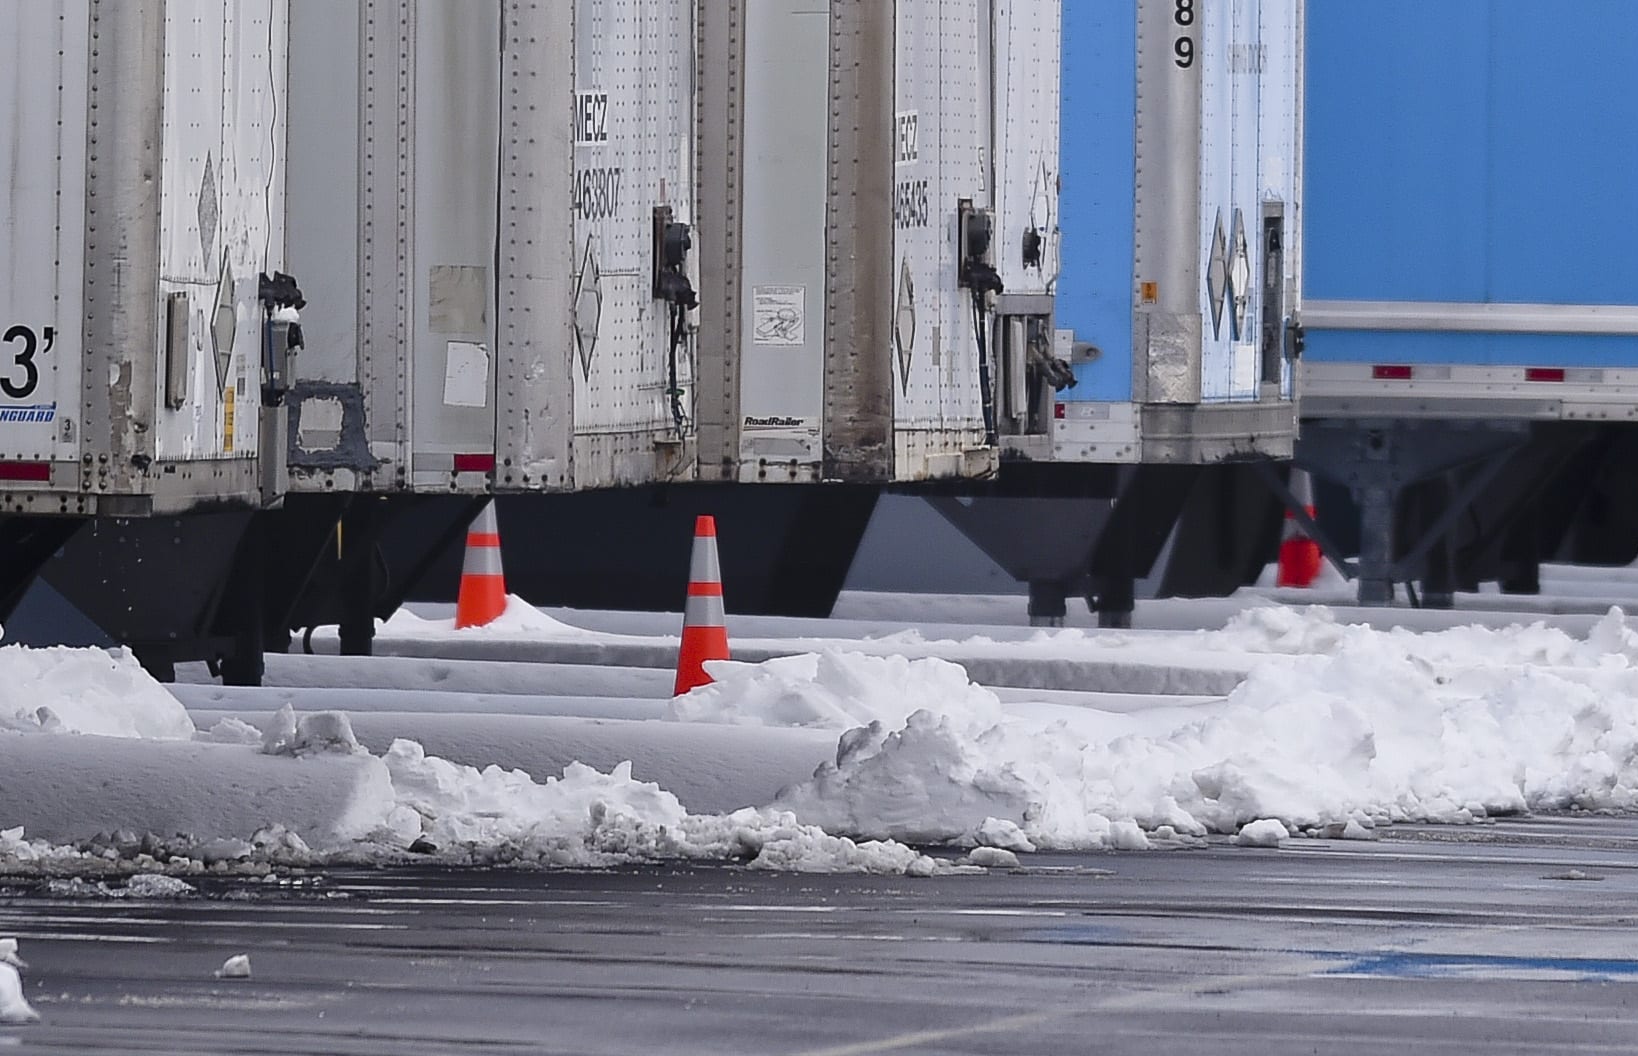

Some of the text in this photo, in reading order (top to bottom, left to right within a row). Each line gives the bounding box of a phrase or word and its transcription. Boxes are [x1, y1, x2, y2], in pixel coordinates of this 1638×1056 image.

[898, 114, 918, 161] ECZ
[574, 167, 620, 221] 463807
[744, 416, 804, 426] RoadRailer
